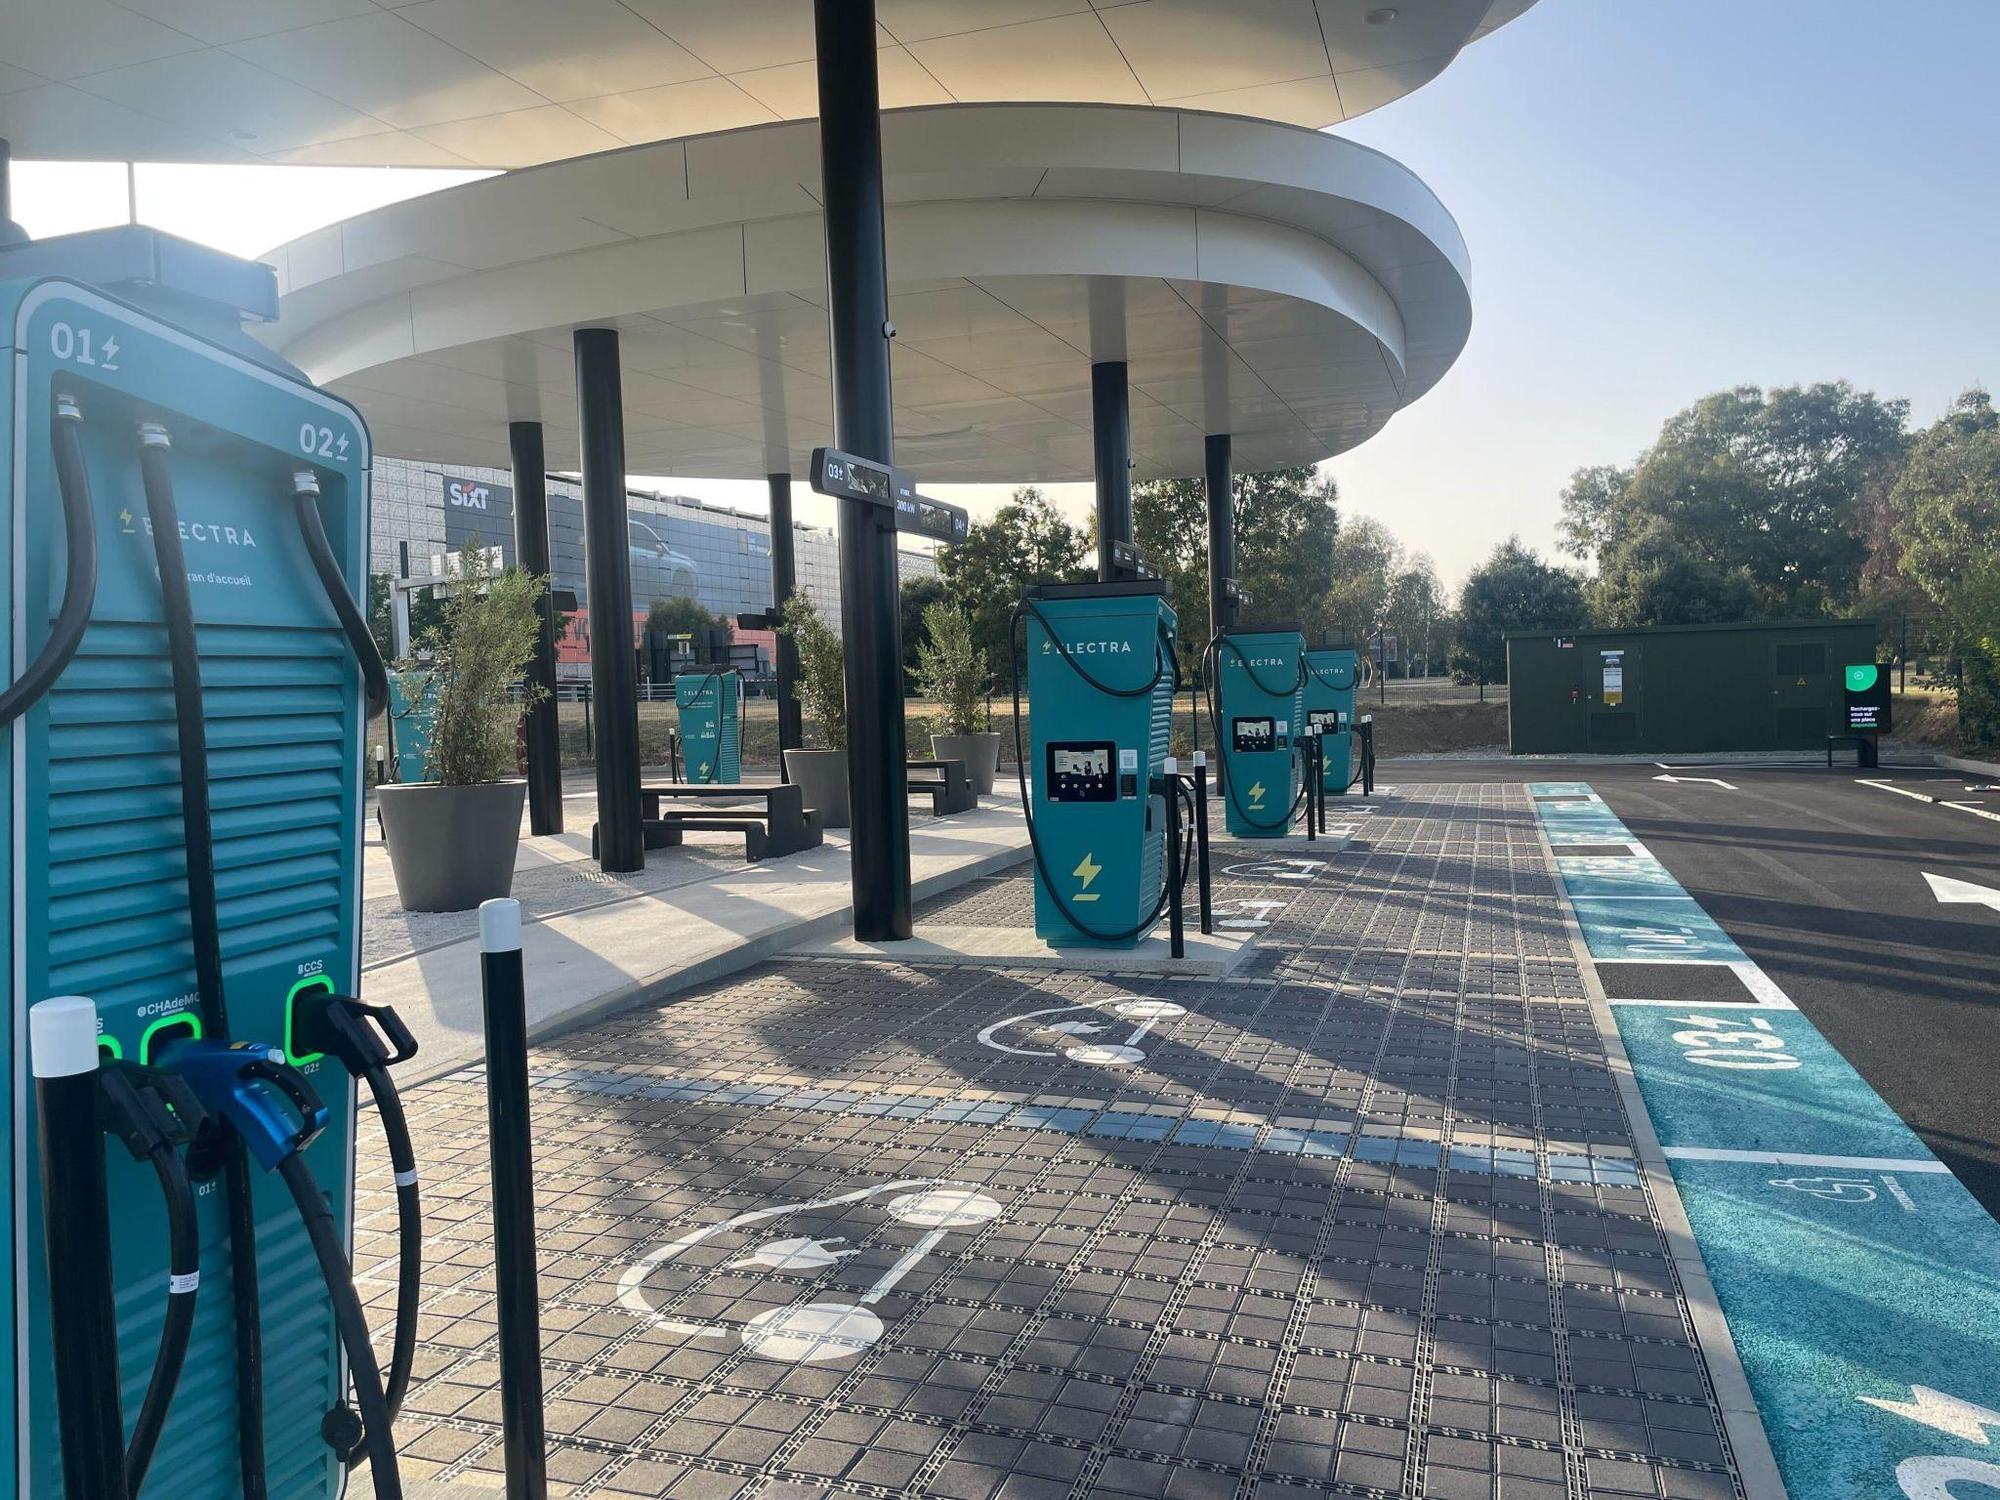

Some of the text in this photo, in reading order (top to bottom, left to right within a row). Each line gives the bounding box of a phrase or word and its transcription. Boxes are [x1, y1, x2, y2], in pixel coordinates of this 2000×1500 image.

[51, 321, 96, 365] 01
[300, 423, 333, 458] 02
[828, 463, 839, 479] 03
[142, 516, 257, 547] EECTRA
[206, 572, 253, 586] d'accueil
[1237, 658, 1284, 667] EECTRA
[304, 959, 323, 973] CCS
[304, 1062, 316, 1075] 02
[199, 1183, 211, 1196] 01
